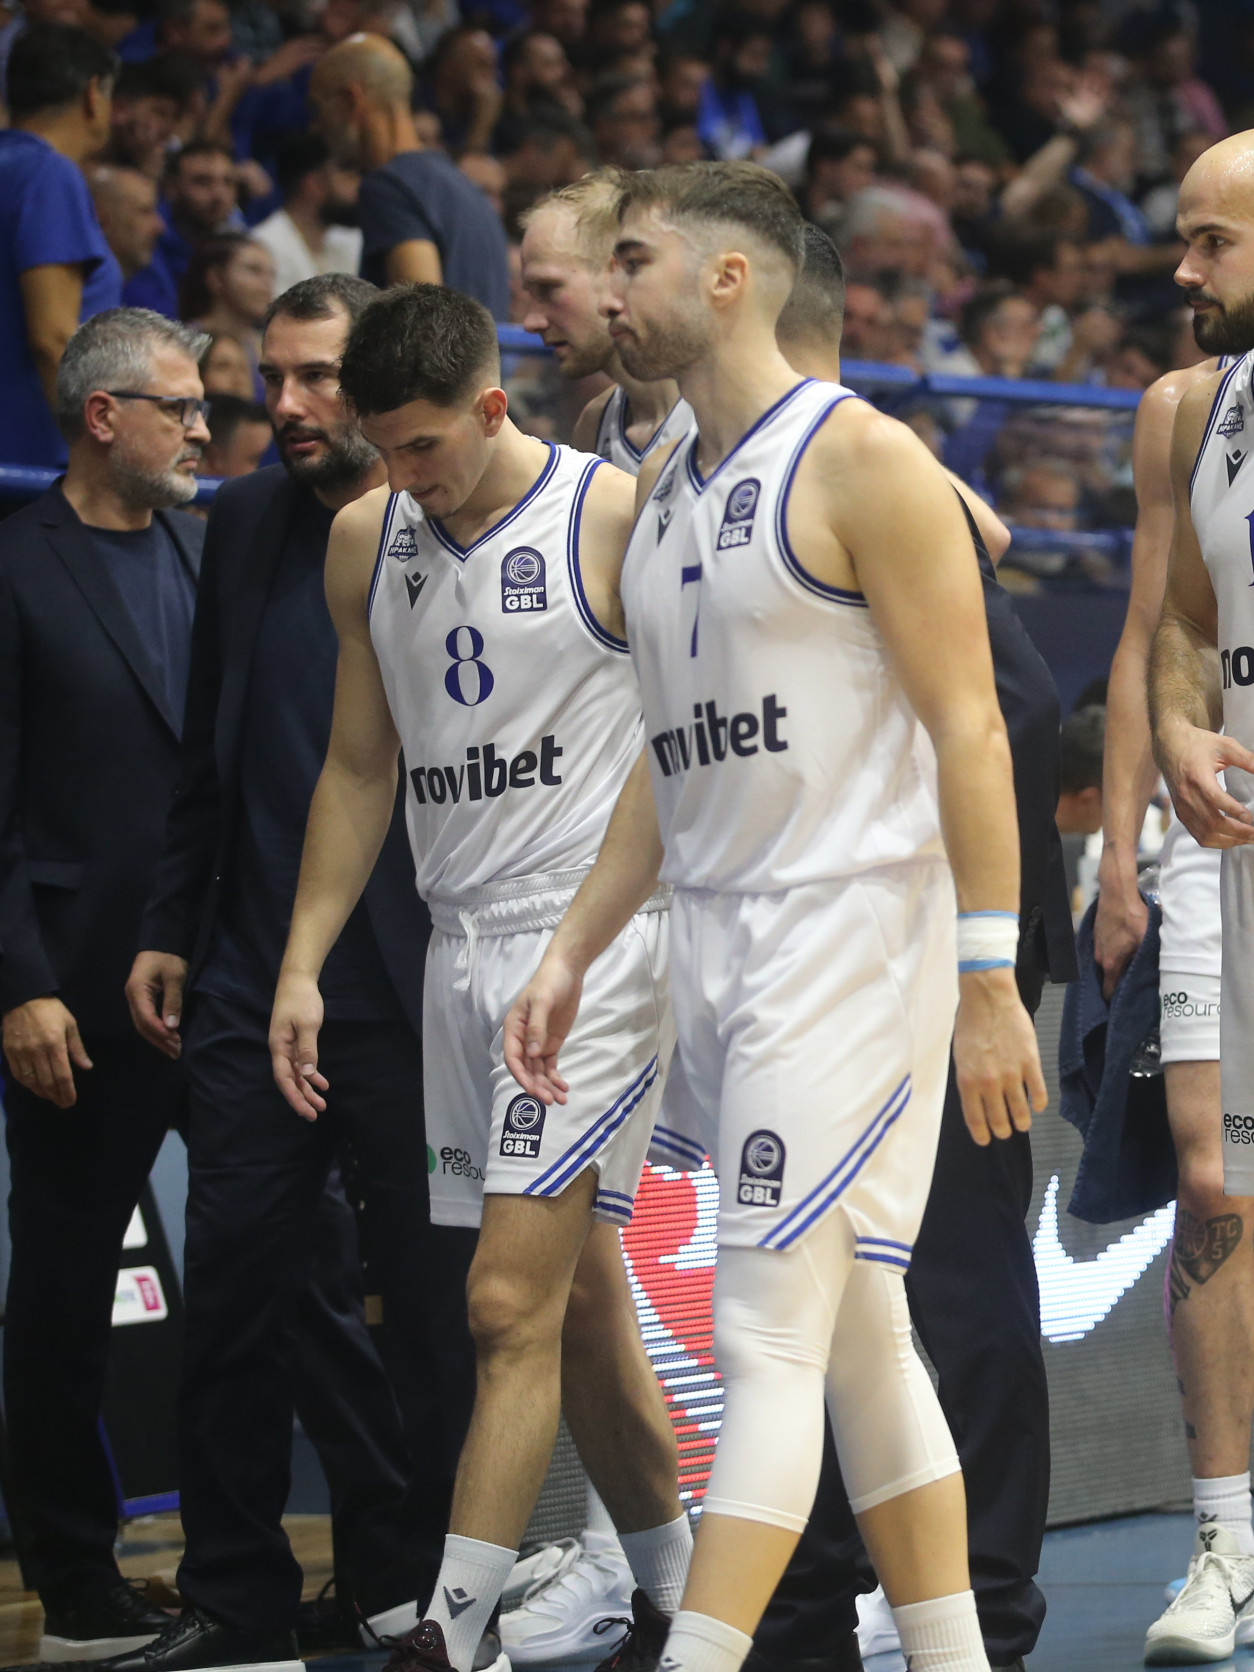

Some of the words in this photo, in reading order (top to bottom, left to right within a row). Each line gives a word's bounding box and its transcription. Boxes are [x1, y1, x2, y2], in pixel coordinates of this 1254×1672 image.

[720, 527, 750, 547] GBL
[503, 586, 545, 596] Stoiximan
[505, 594, 544, 610] GBL
[682, 562, 702, 658] 7
[444, 625, 495, 707] 8
[1163, 991, 1188, 1006] eco
[503, 1130, 540, 1142] Stoiximan
[440, 1146, 472, 1165] eco
[502, 1139, 536, 1156] GBL
[739, 1184, 777, 1206] GBL
